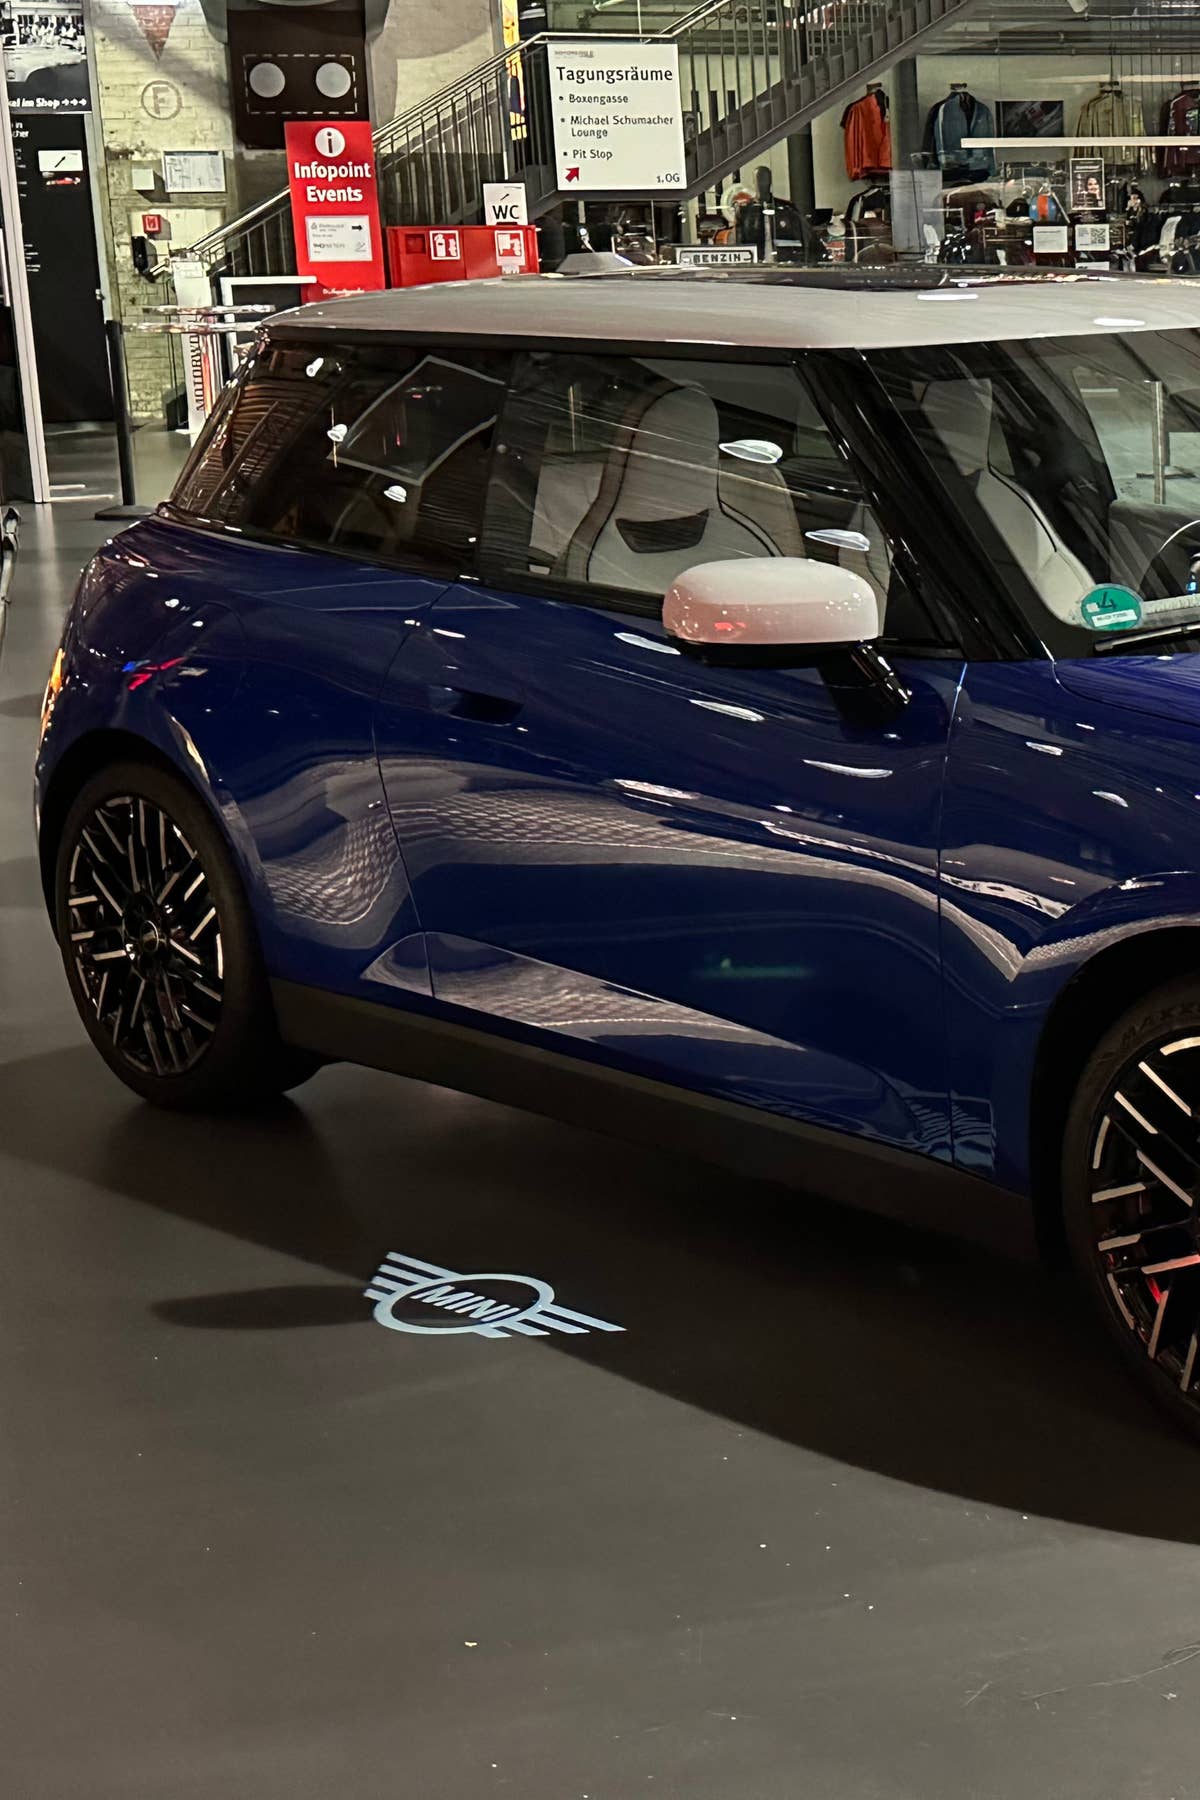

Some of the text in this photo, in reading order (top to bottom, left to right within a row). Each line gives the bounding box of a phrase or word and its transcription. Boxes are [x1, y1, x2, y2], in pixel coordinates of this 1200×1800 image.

[556, 66, 673, 84] Tagungsräume
[569, 93, 629, 105] Boxengasse
[570, 115, 674, 125] Michael Schumacher
[571, 128, 608, 139] Lounge
[573, 149, 613, 161] Pit Stop
[294, 161, 372, 182] Infopoint
[306, 185, 363, 202] Events
[492, 204, 520, 220] WC
[693, 254, 741, 264] BENZIN
[410, 1285, 520, 1322] MINI
